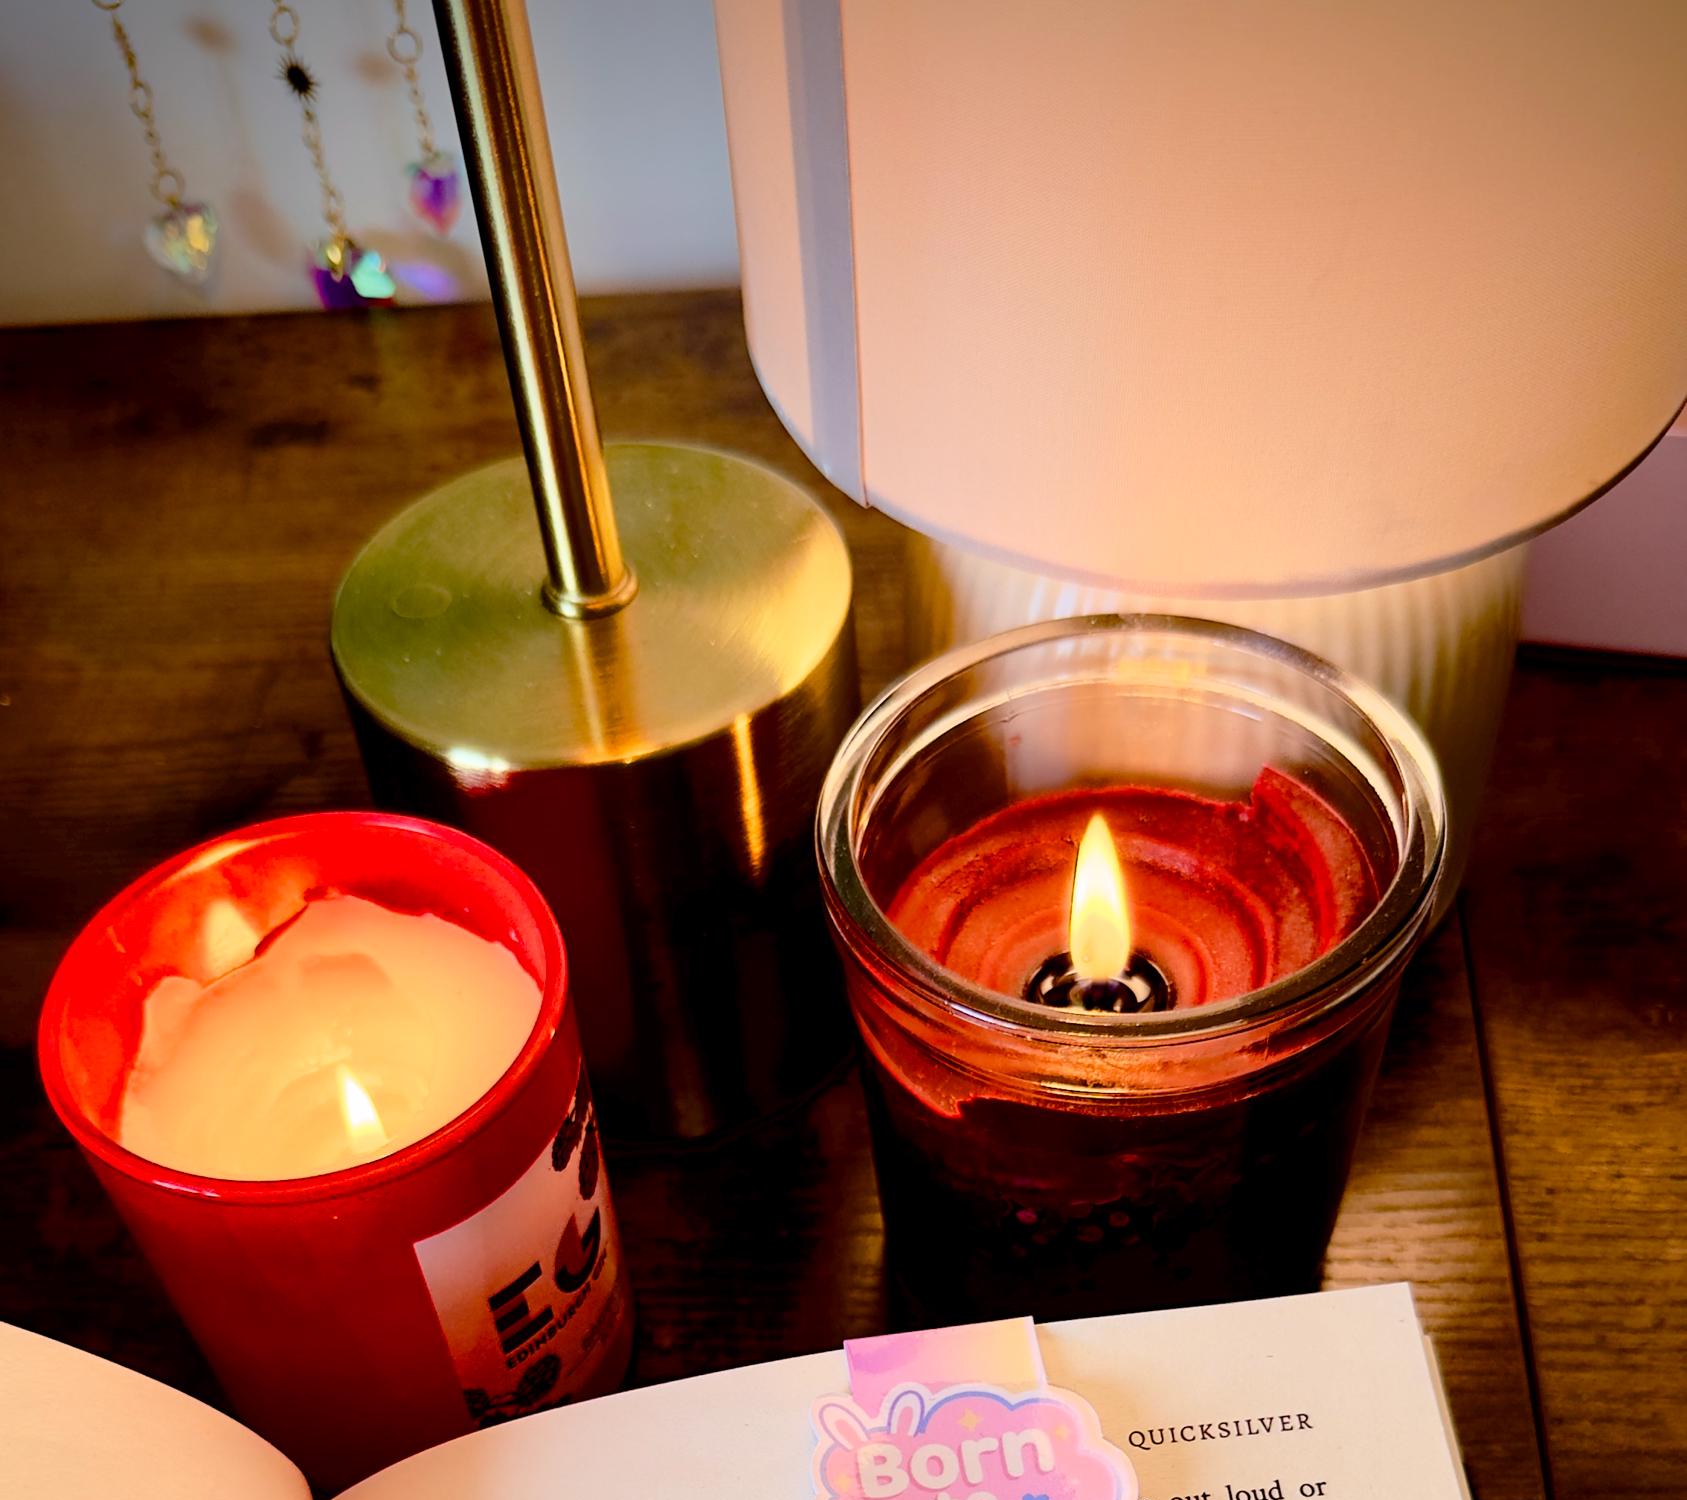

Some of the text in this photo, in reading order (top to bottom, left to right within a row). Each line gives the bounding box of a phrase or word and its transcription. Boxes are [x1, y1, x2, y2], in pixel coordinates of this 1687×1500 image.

[1128, 1413, 1314, 1450] QUICKSILVER
[857, 1428, 1054, 1499] Born
[1300, 1482, 1326, 1497] or
